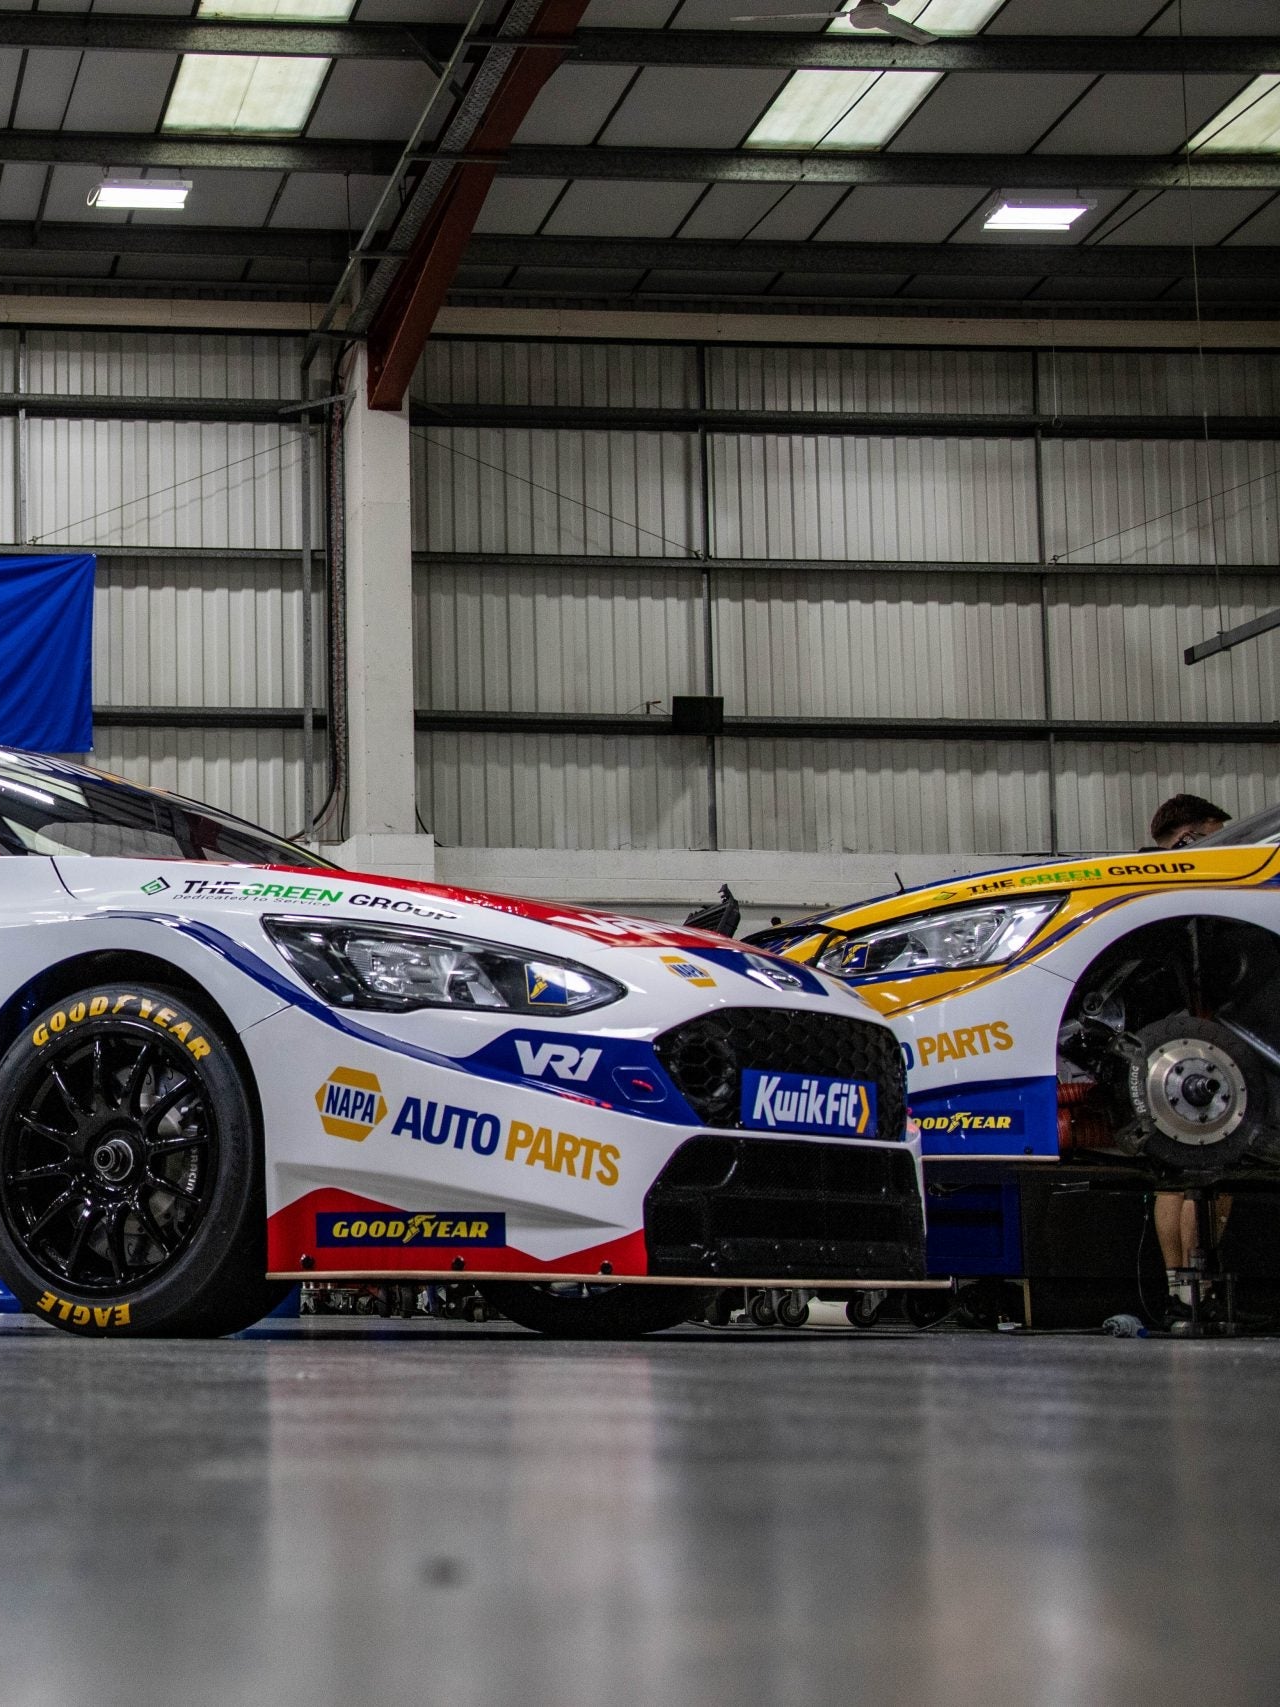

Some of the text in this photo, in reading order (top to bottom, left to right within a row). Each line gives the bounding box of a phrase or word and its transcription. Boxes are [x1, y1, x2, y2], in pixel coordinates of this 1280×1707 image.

[184, 880, 241, 895] THE
[242, 883, 344, 903] GREEN
[967, 880, 1014, 892] THE
[1020, 868, 1101, 885] GREEN
[1108, 863, 1195, 876] GROUP
[514, 1039, 603, 1082] VR1
[916, 1021, 1014, 1066] PARTS
[325, 1084, 620, 1187] NAPA AUTO PARTS
[913, 1114, 1012, 1131] OODYEAR
[37, 1291, 131, 1328] EAGLE
